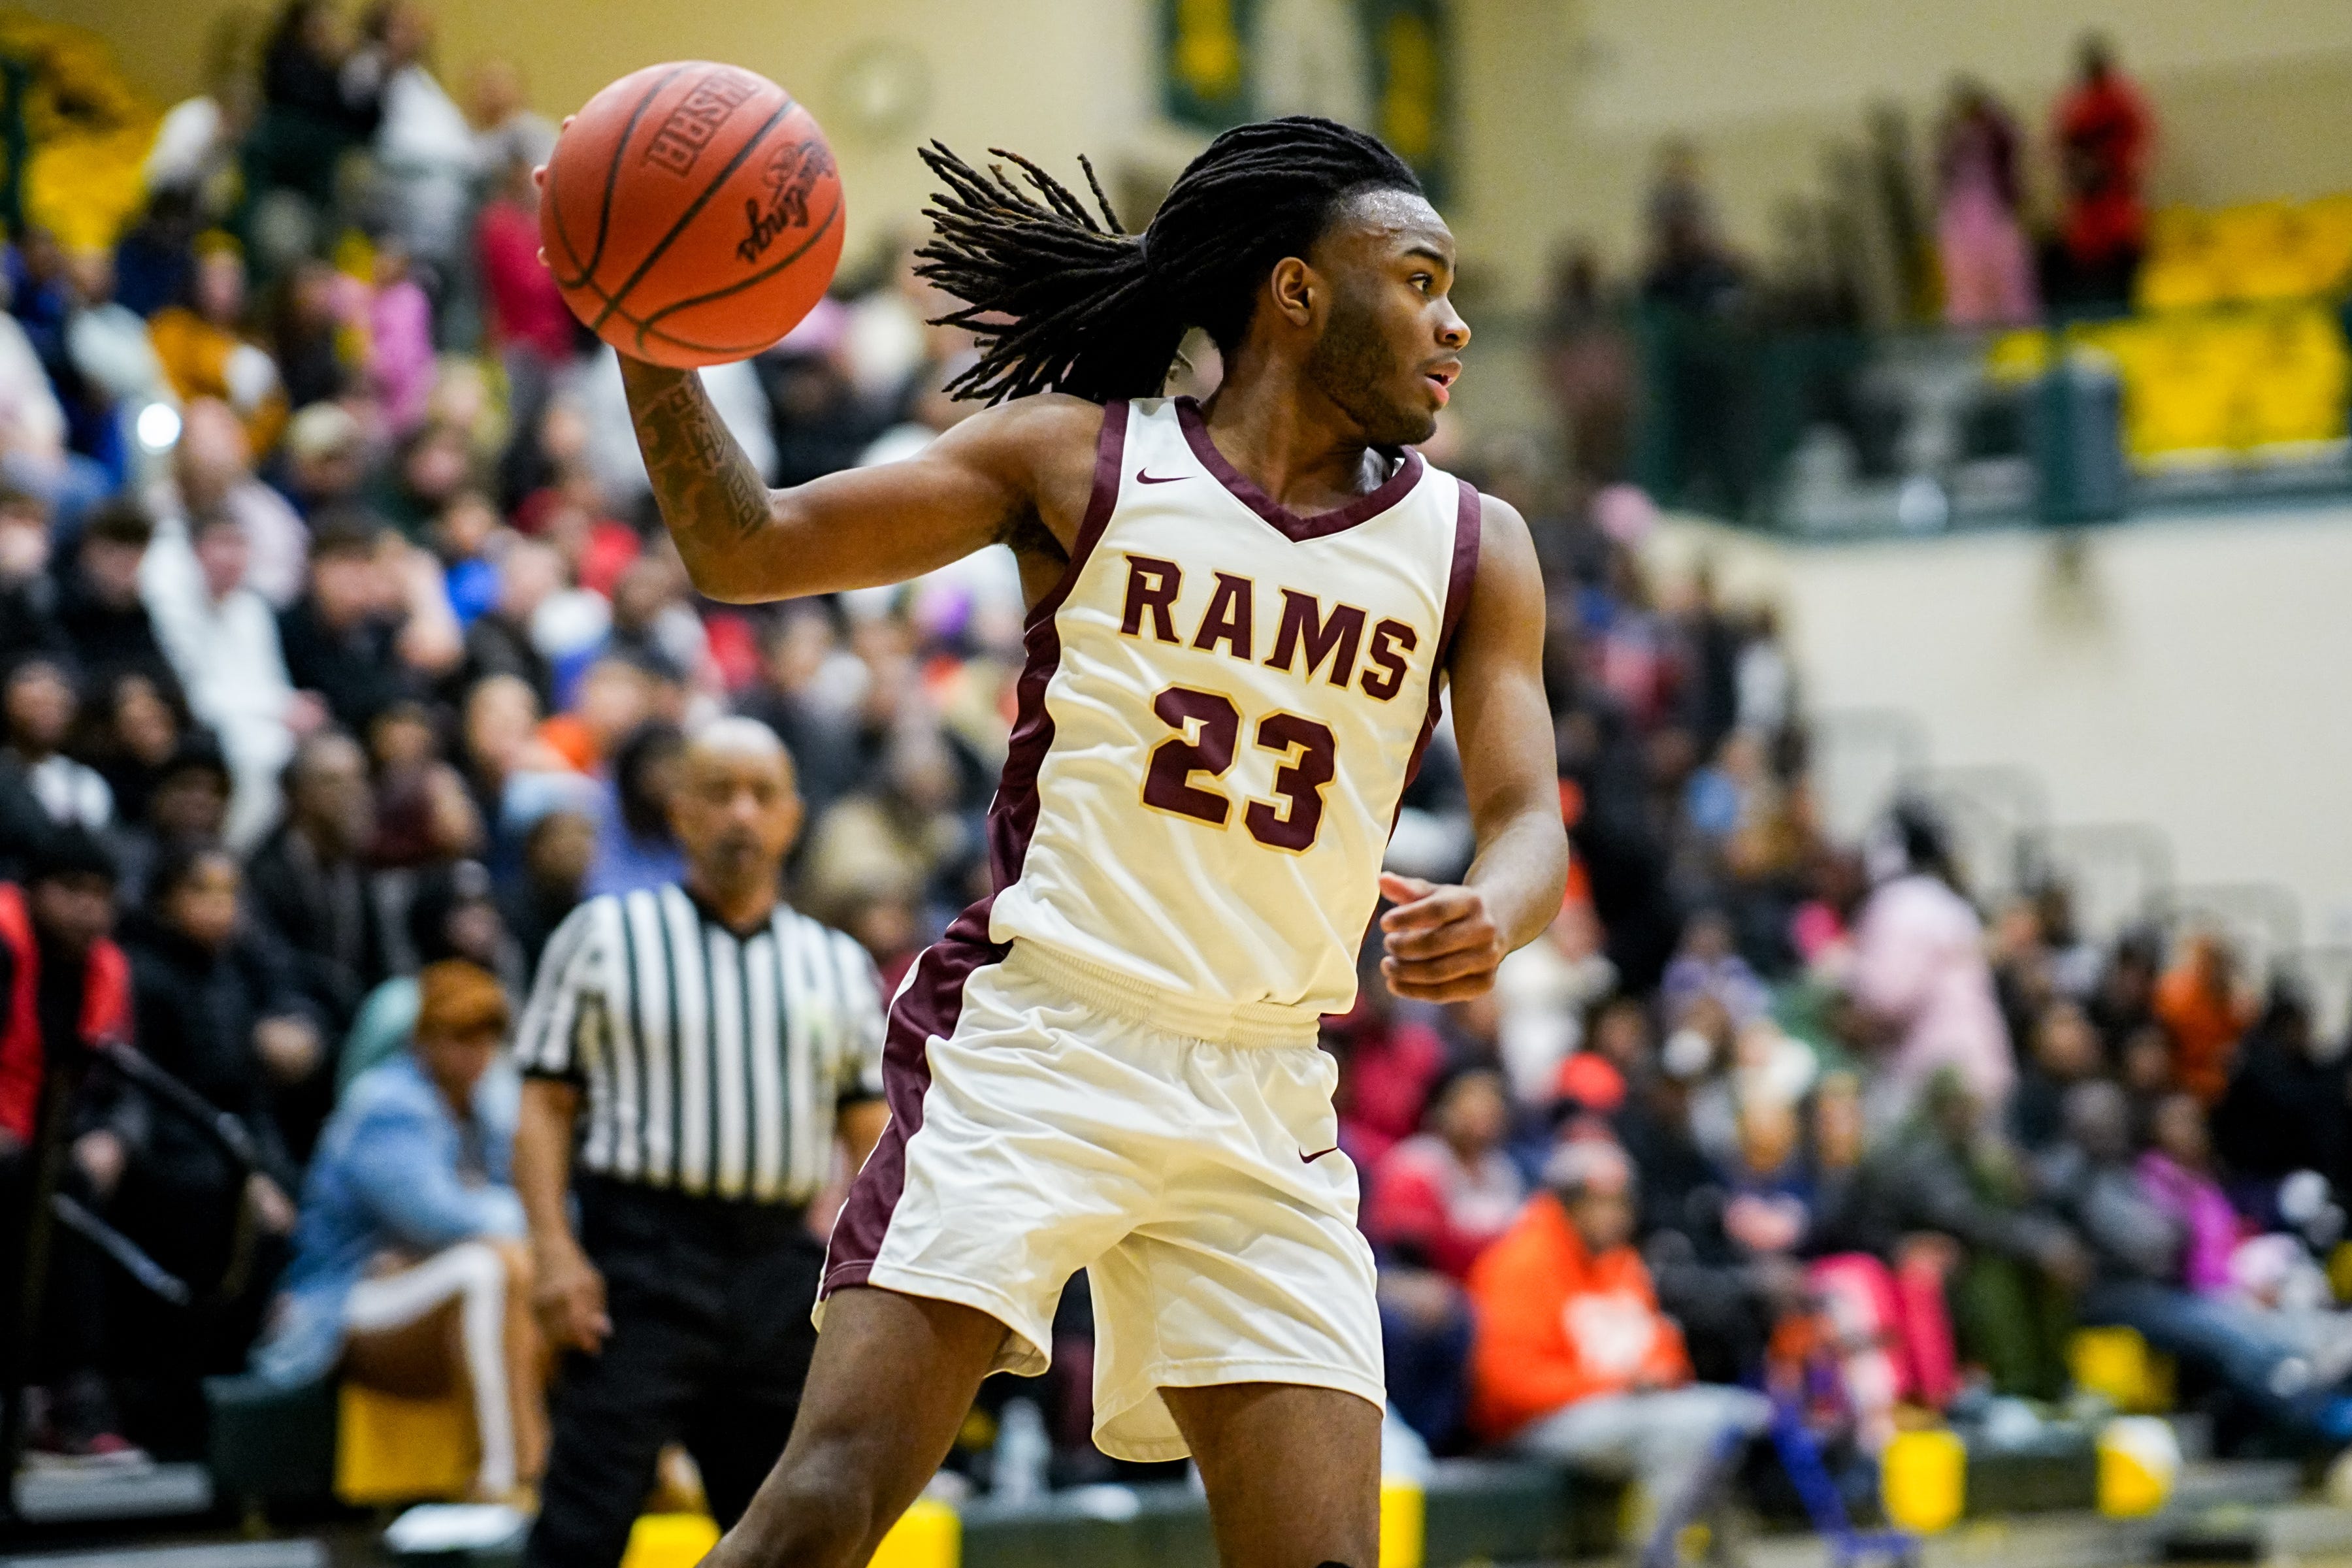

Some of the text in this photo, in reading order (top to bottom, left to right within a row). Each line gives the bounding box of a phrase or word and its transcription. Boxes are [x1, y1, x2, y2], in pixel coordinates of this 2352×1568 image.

[736, 139, 834, 265] lings
[1118, 551, 1420, 704] RAMS
[1139, 681, 1339, 857] 23
